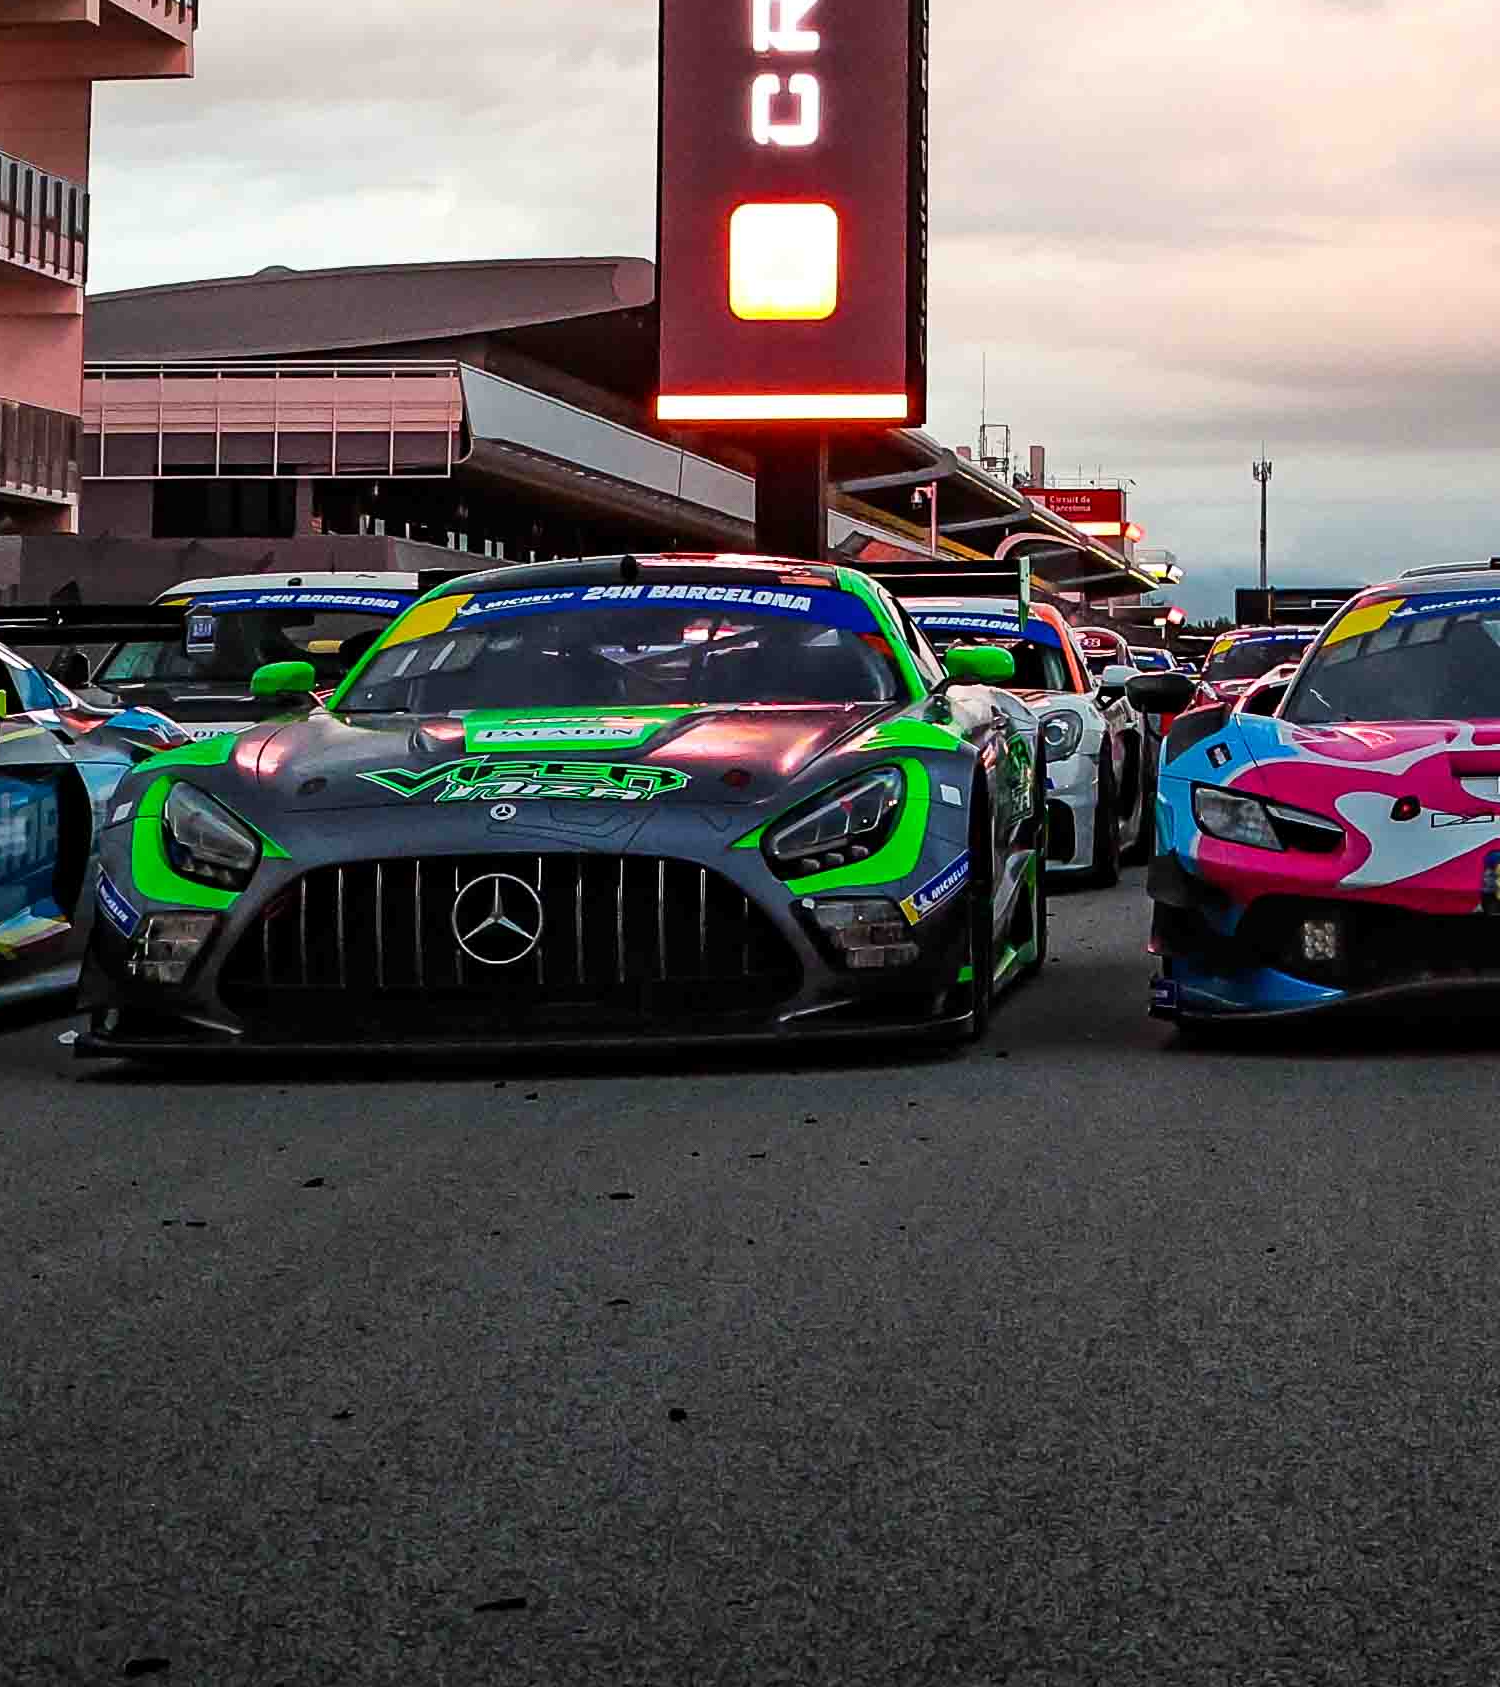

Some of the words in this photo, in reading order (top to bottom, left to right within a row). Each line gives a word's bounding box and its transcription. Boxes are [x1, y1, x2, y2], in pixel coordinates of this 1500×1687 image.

[1049, 496, 1078, 504] Circuit
[1080, 495, 1091, 504] de
[254, 594, 295, 604] 24H
[296, 593, 399, 609] BARCELONA
[484, 591, 575, 610] MICHELIN
[581, 586, 642, 602] 24H
[647, 585, 812, 612] BARCELONA
[485, 727, 634, 738] PALADIN
[356, 755, 692, 798] VIPER
[931, 860, 969, 900] MICHELIN
